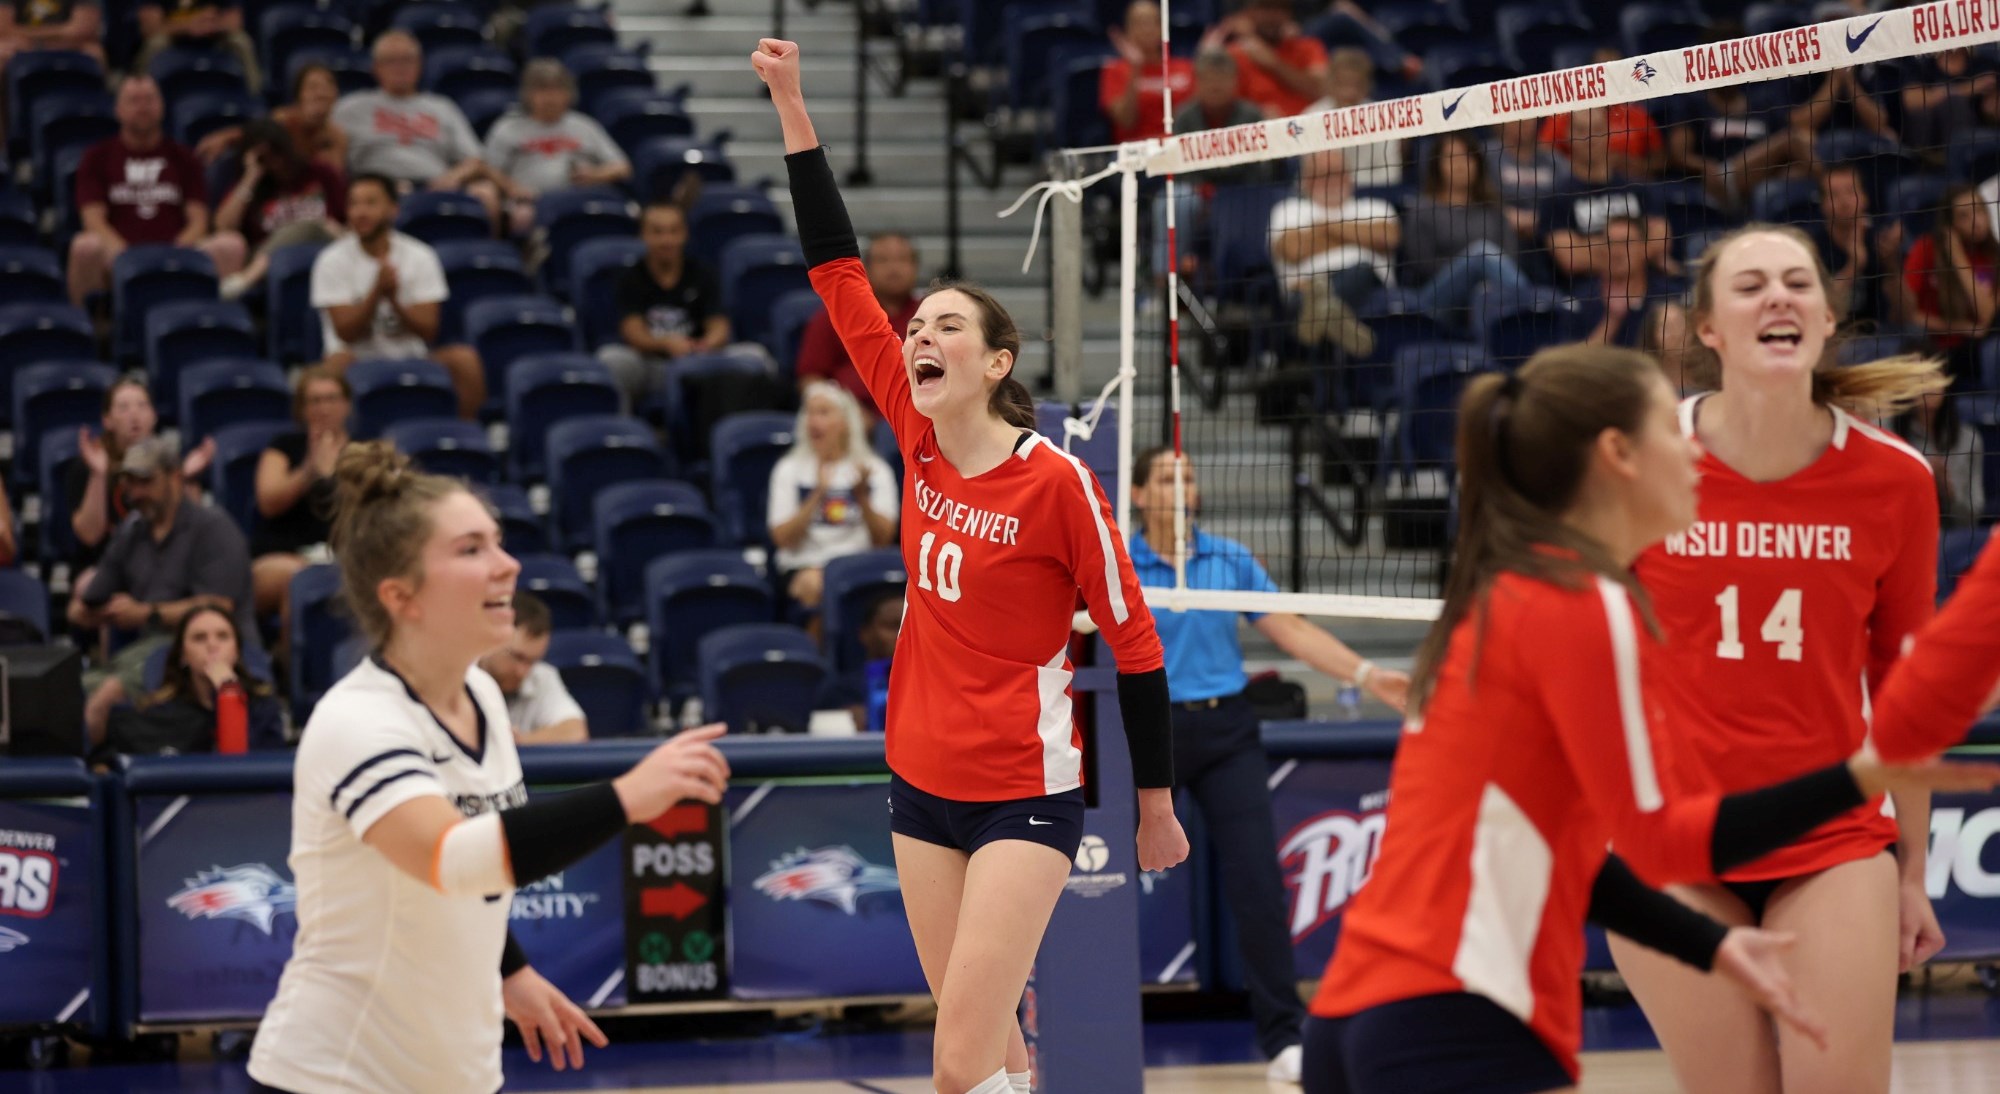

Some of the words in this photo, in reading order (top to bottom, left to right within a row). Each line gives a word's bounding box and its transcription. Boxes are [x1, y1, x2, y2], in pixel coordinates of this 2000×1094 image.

[1683, 26, 1821, 83] ROADRUNNERS
[1490, 65, 1606, 114] ROADRUNNERS
[1323, 97, 1423, 140] ROADRUNNERS
[945, 498, 1019, 546] DENVER
[1736, 521, 1852, 561] DENVER
[918, 531, 963, 603] 10
[1715, 584, 1804, 662] 14
[632, 842, 715, 877] POSS
[636, 962, 717, 993] BONUS
